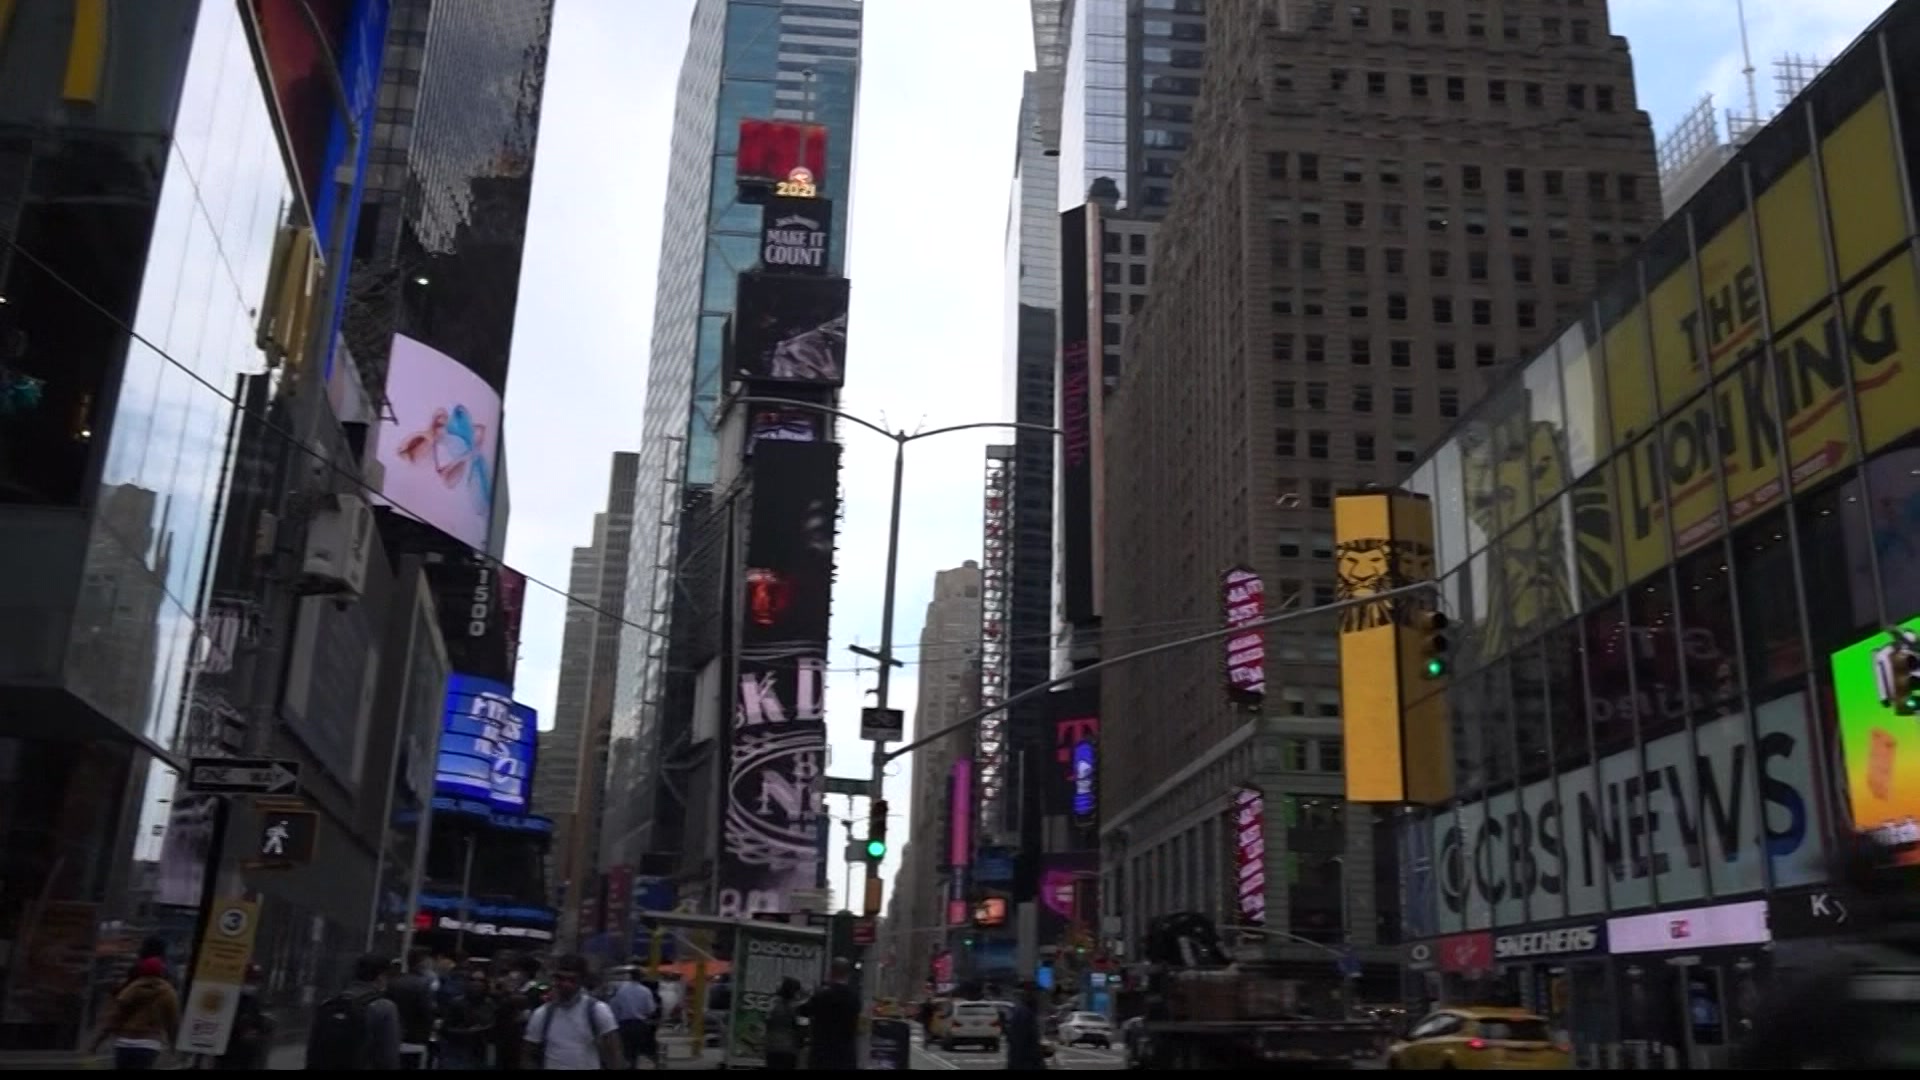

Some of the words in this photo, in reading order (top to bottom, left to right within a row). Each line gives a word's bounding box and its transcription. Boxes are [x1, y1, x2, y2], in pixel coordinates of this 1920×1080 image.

[775, 182, 816, 198] 2021
[767, 230, 808, 247] MAKE
[809, 231, 827, 247] IT
[765, 244, 825, 267] COUNT
[1680, 266, 1759, 364] THE
[1624, 390, 1737, 540] LION
[1738, 284, 1898, 471] KING
[1474, 802, 1566, 906] CBS
[1579, 731, 1807, 889] NEWS
[1495, 925, 1598, 957] SKECHERS
